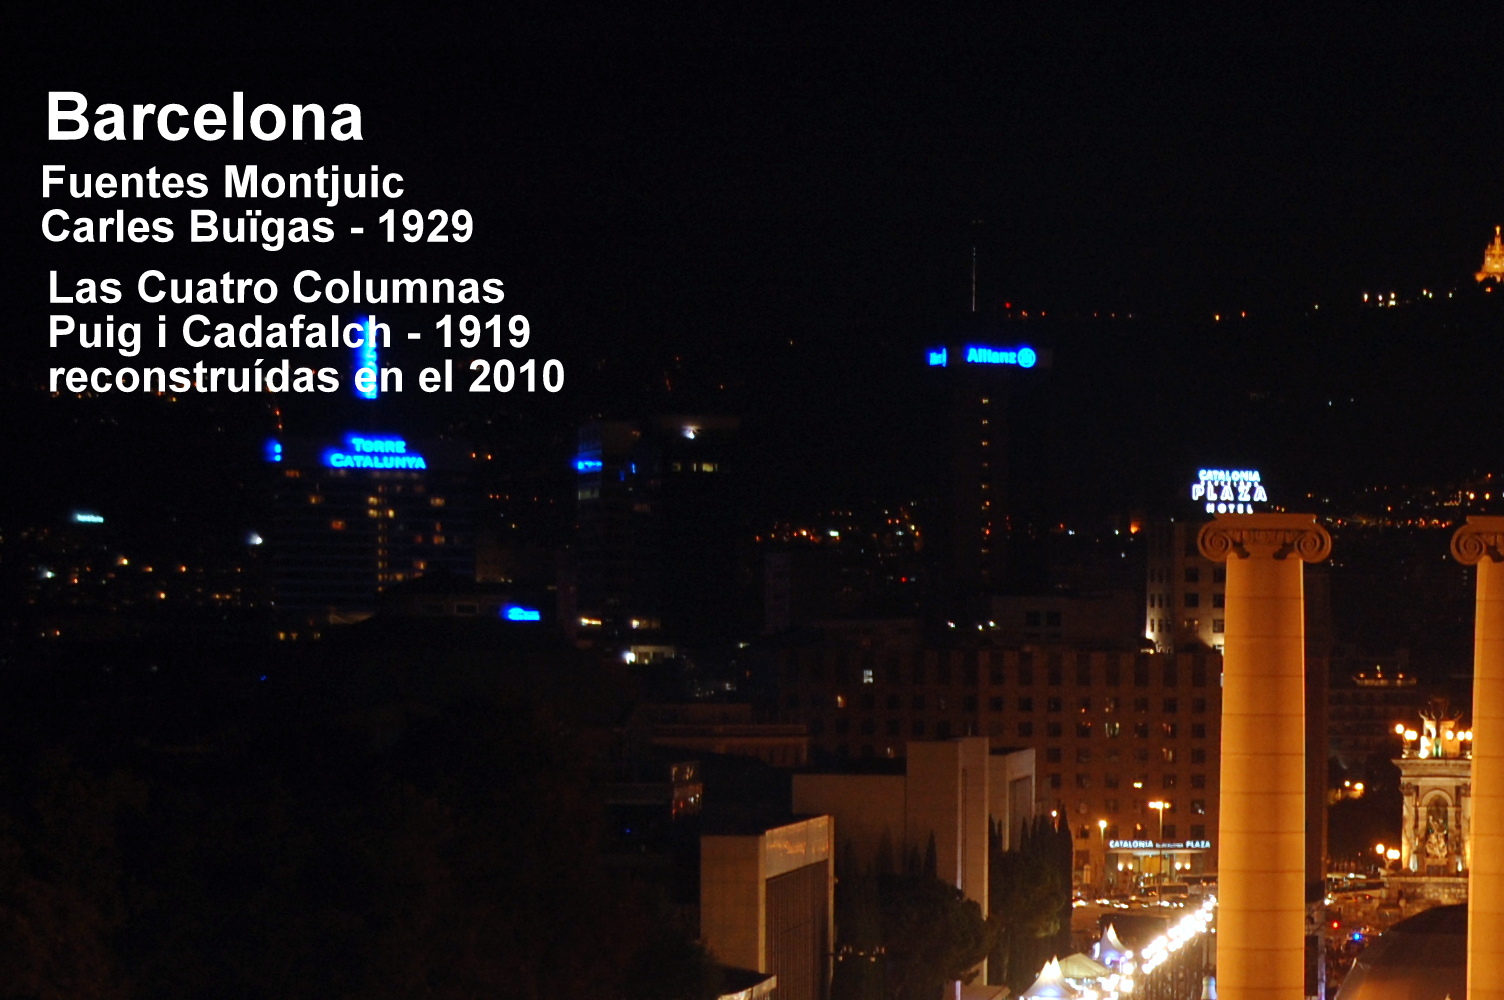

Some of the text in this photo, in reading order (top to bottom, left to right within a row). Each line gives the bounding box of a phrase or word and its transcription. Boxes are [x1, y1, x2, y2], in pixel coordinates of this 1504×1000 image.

[967, 347, 1017, 364] Allianz
[330, 453, 427, 469] CATALUNYA
[1198, 469, 1261, 483] CATALONIA
[1192, 483, 1268, 502] PLAZA
[1109, 839, 1154, 849] CATALONIA
[1185, 840, 1211, 849] PLAZA
